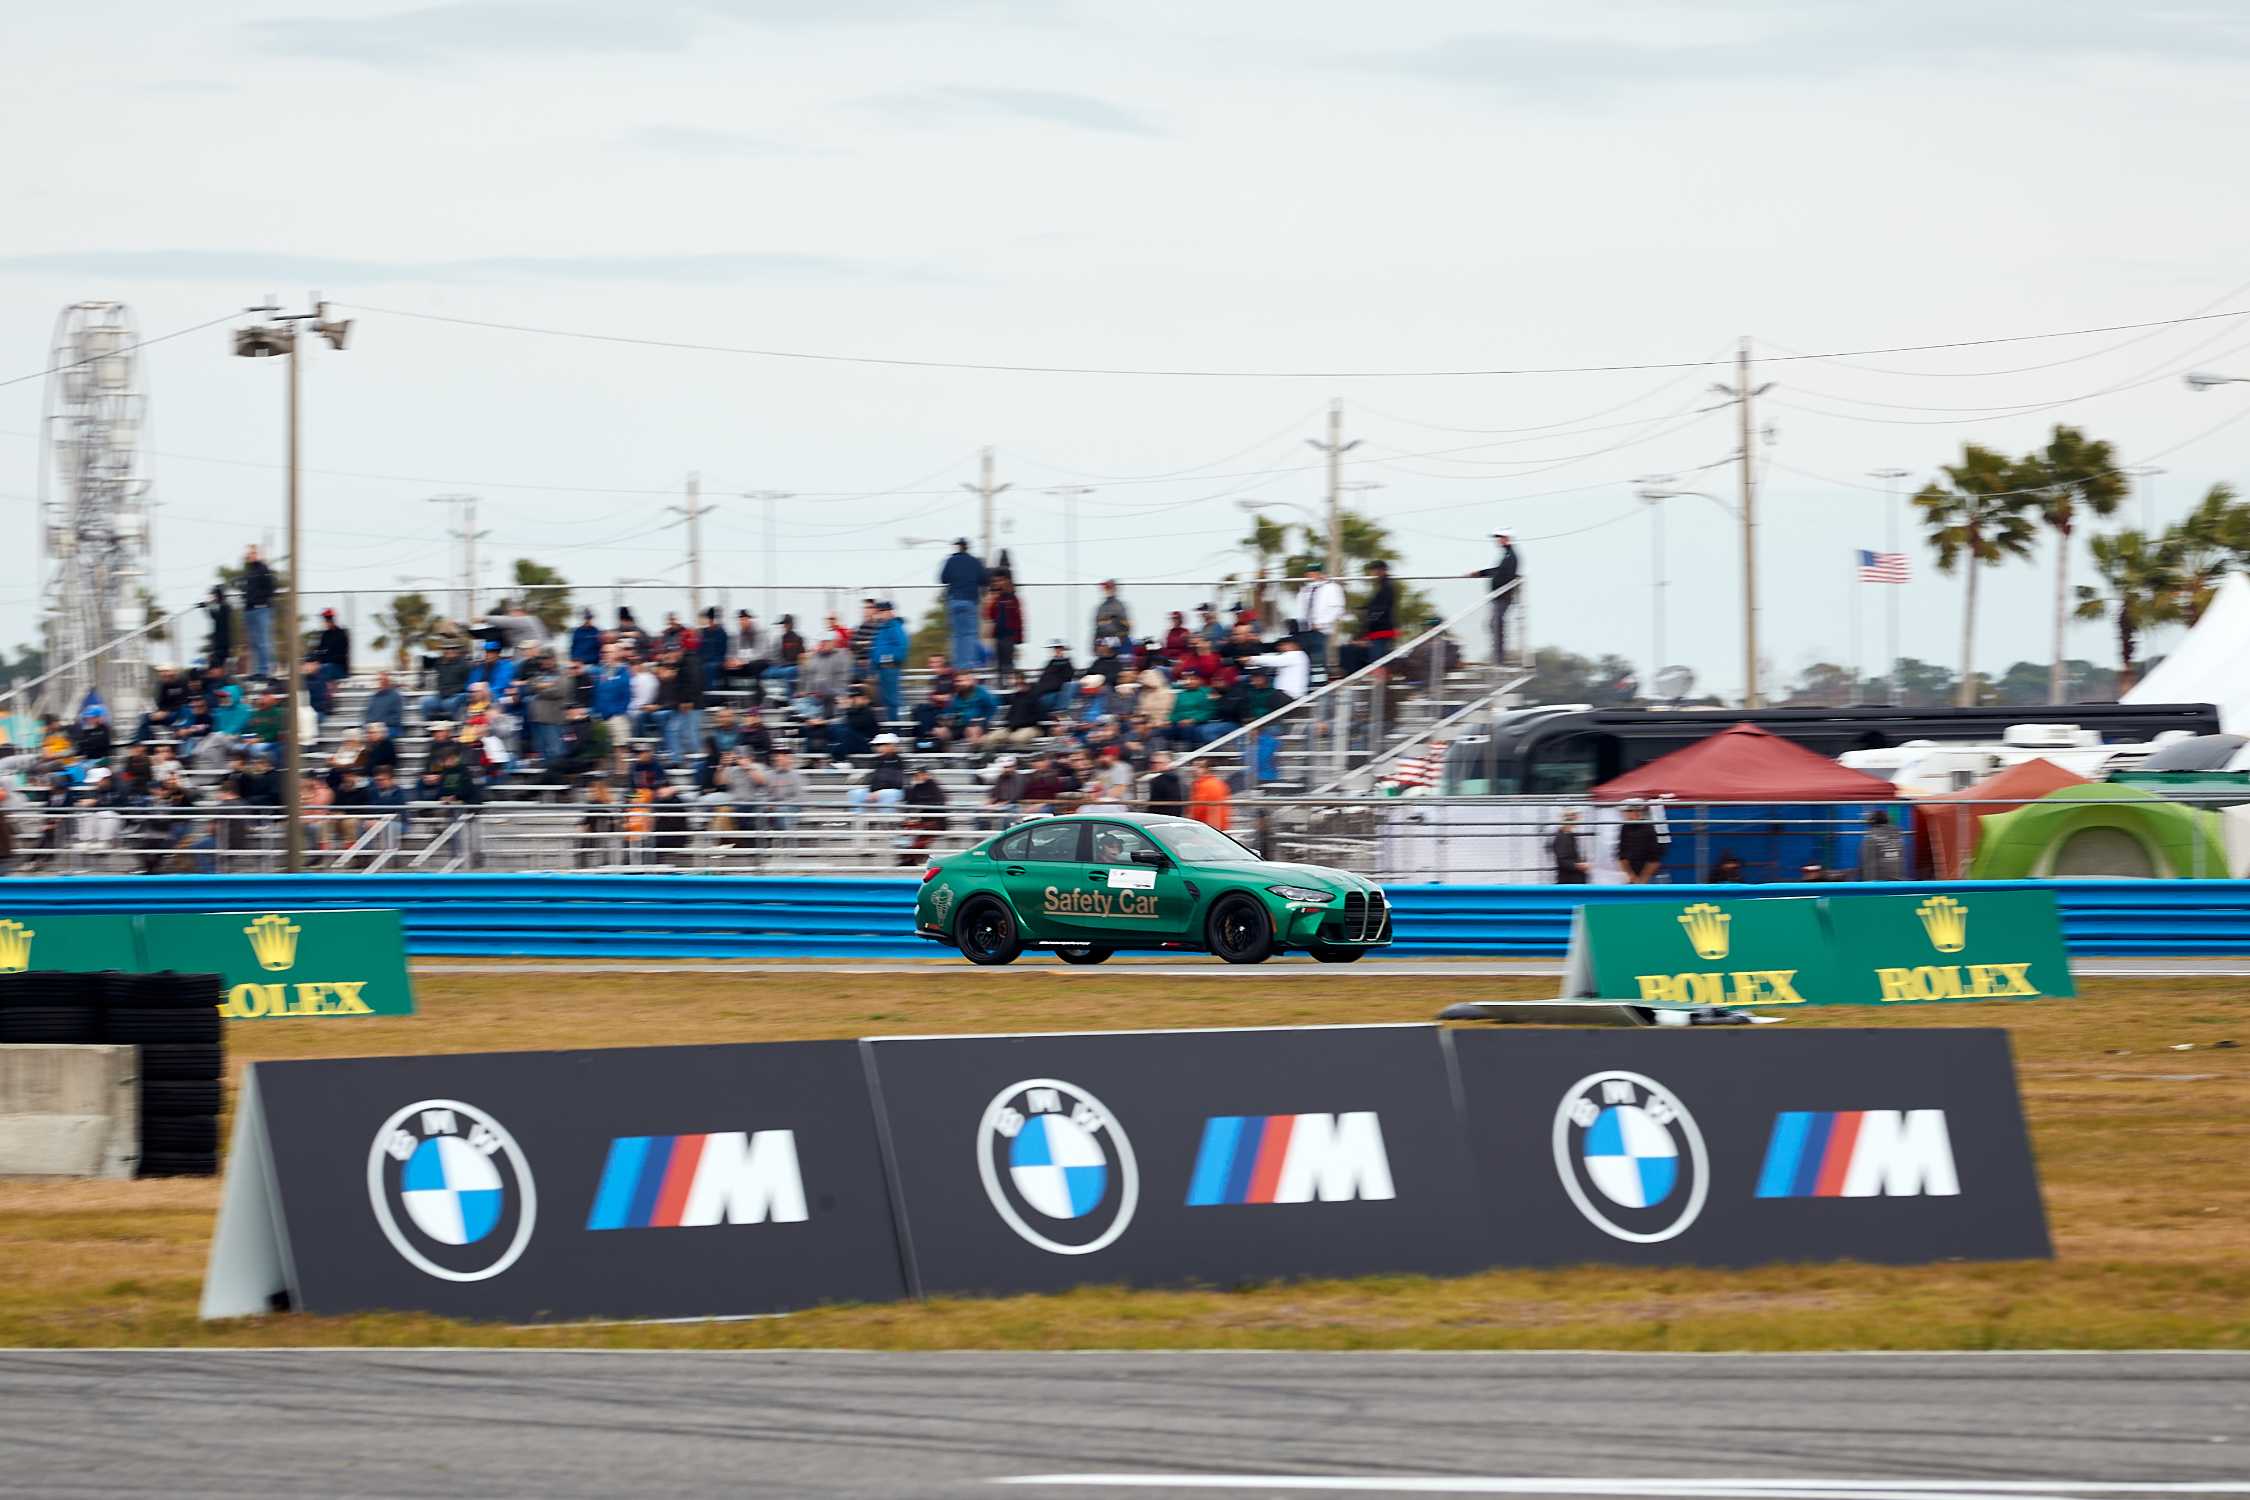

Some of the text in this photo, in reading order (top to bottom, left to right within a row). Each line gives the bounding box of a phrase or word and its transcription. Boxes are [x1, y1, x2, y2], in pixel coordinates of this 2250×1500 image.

[1044, 886, 1159, 917] Safety Car
[1634, 969, 1807, 1005] ROLEX
[1874, 963, 2041, 1001] ROLEX
[992, 1088, 1106, 1137] BMW
[1567, 1080, 1680, 1128] BMW
[383, 1108, 503, 1160] BMW
[1273, 1111, 1397, 1204] M
[1840, 1109, 1961, 1198] M
[679, 1129, 809, 1226] M
